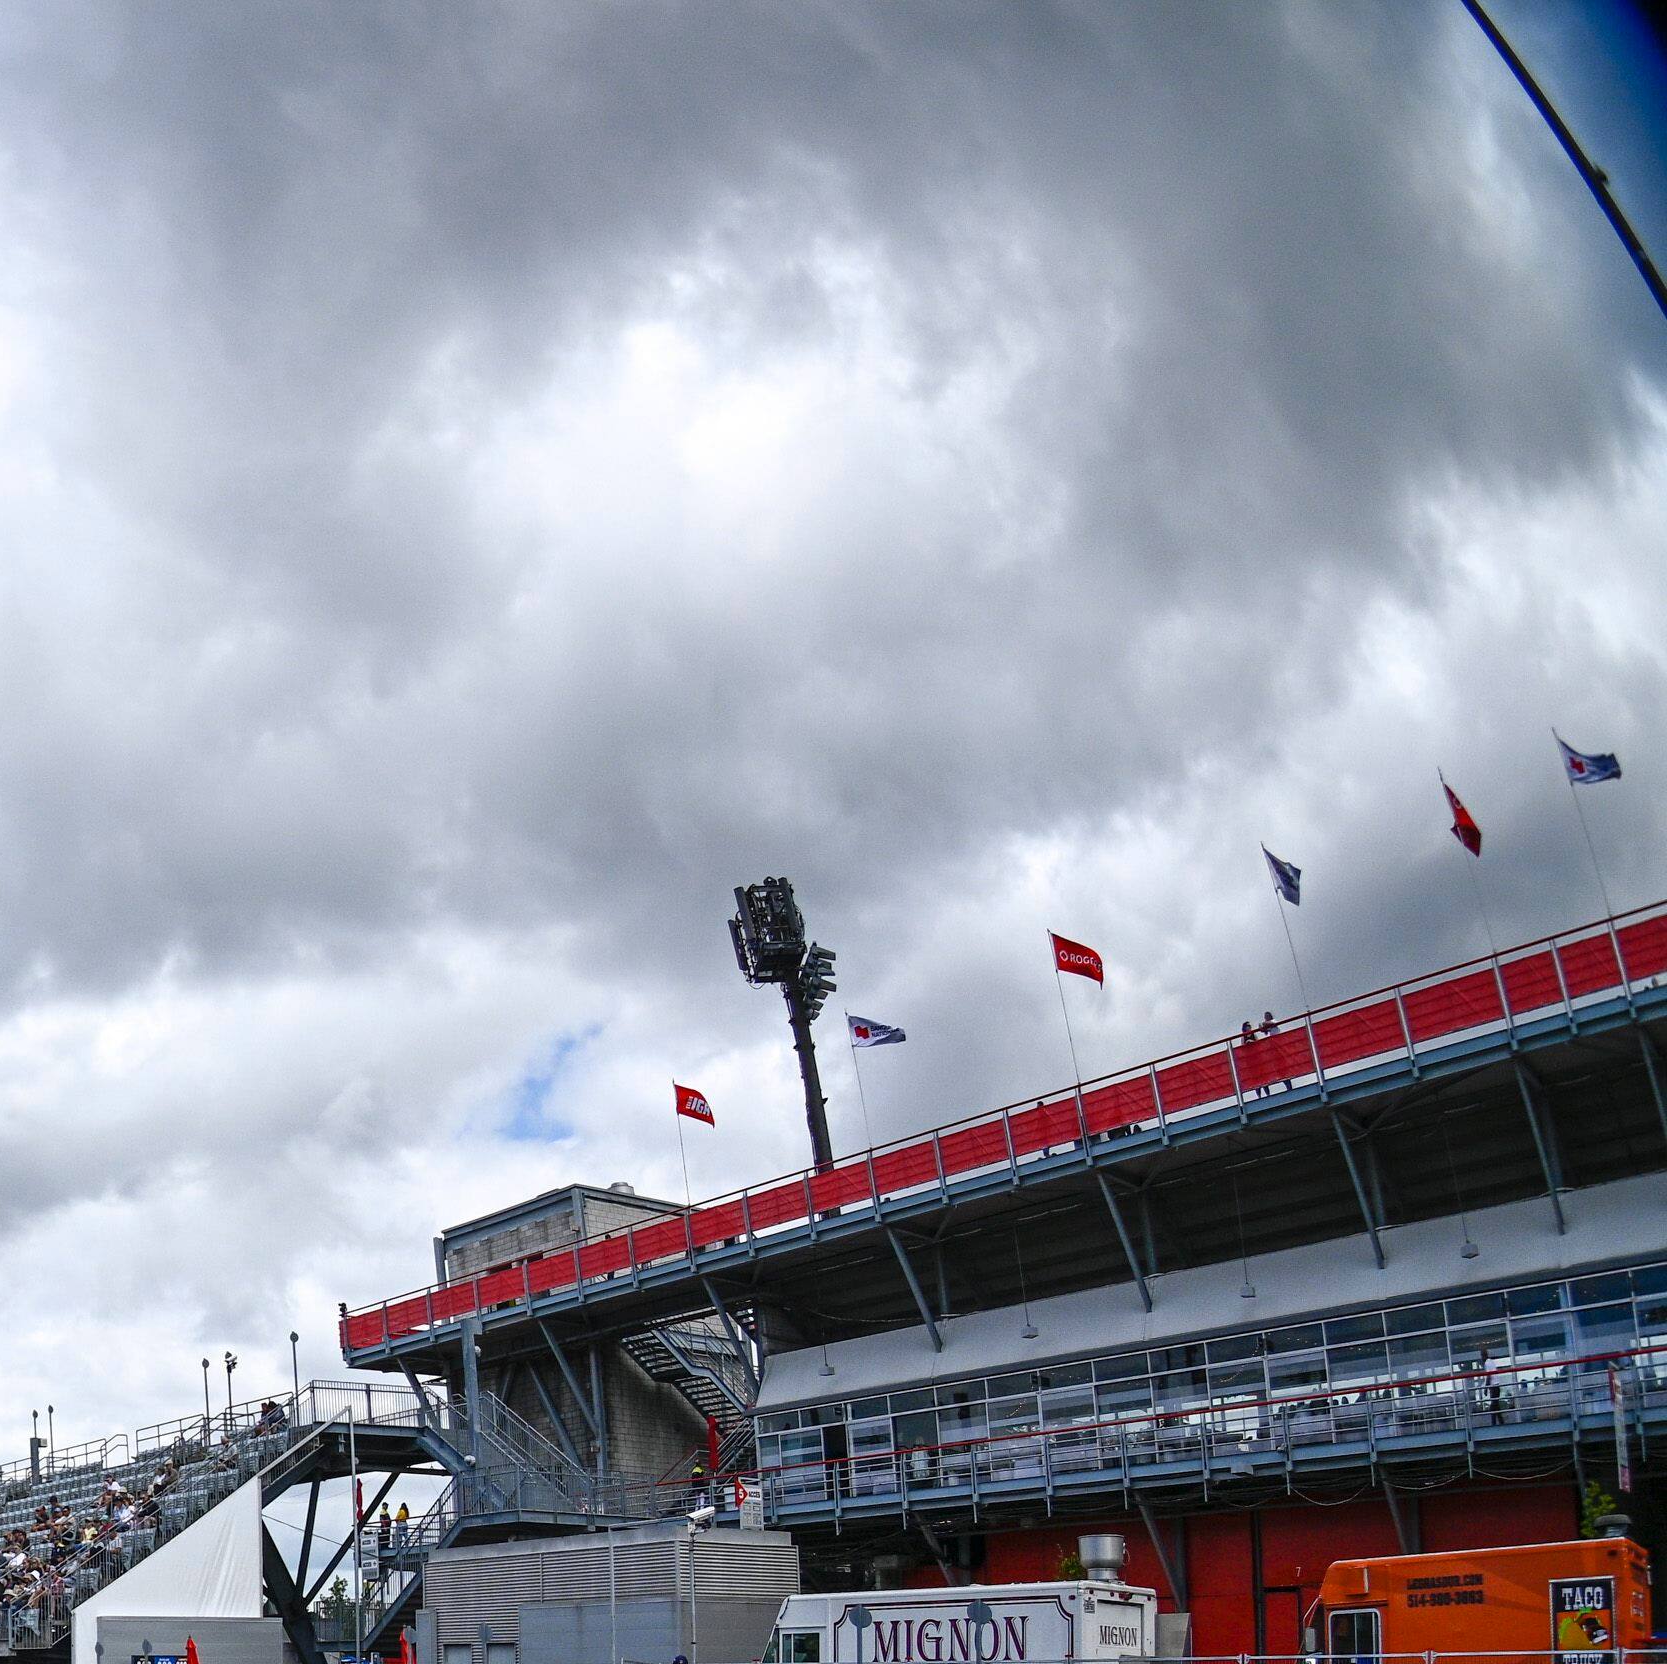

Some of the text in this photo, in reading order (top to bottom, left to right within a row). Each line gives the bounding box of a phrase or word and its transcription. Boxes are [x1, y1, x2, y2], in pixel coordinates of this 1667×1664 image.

[1562, 1586, 1604, 1611] TACO
[872, 1615, 1030, 1663] MIGNON
[1099, 1625, 1138, 1648] MIGNON
